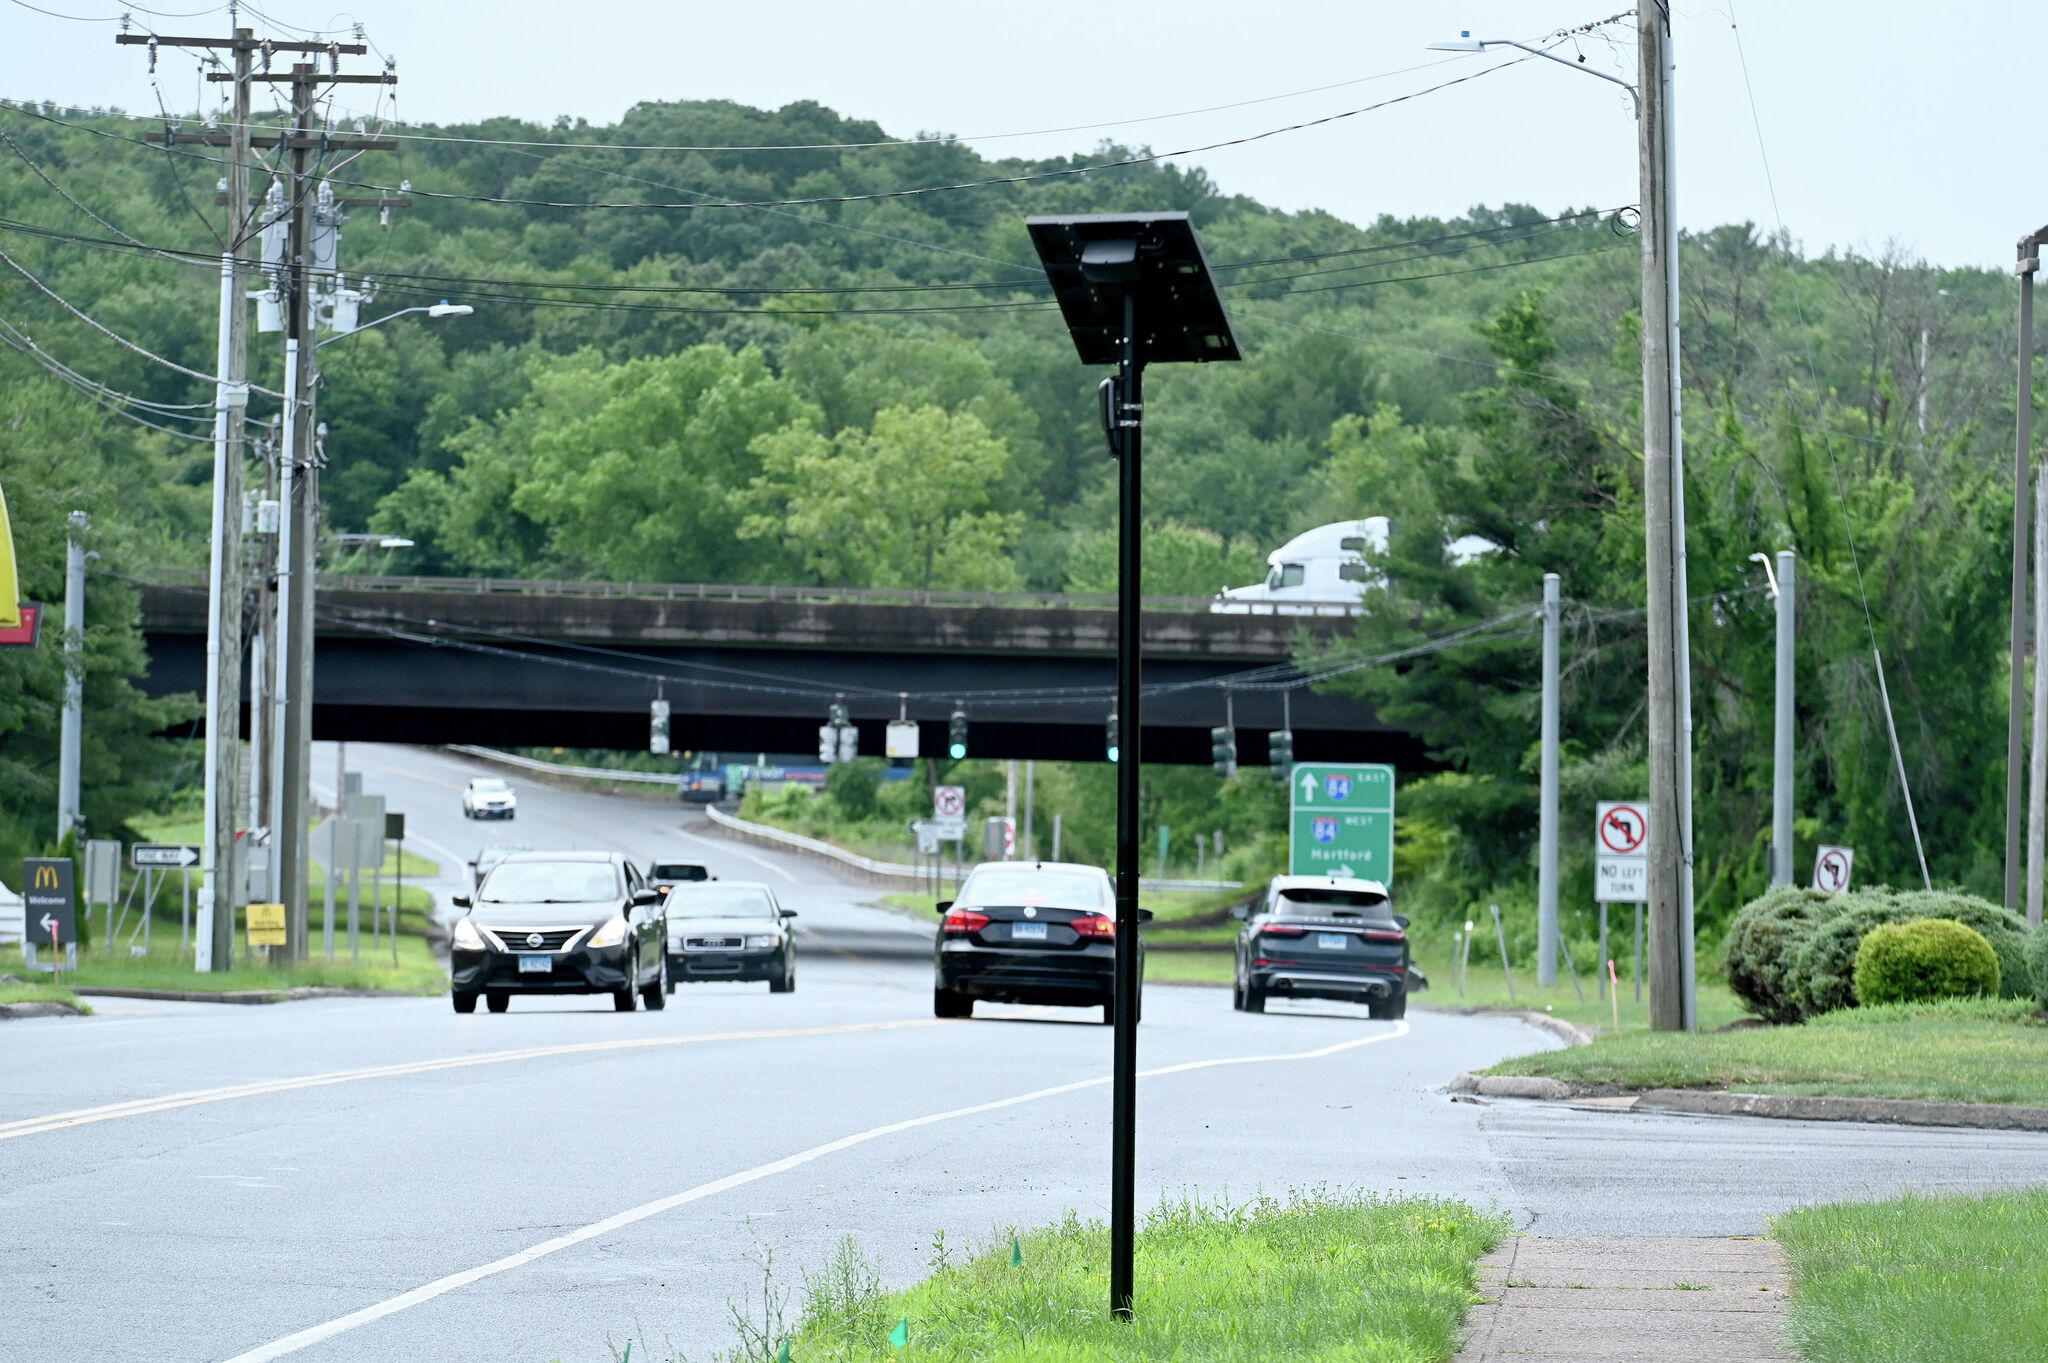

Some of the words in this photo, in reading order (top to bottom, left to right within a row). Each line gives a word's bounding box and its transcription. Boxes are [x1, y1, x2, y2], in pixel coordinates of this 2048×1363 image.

[1357, 773, 1386, 783] EAST
[1345, 816, 1373, 826] WEST
[1311, 849, 1371, 861] Hartford
[1601, 865, 1617, 878] NO
[1622, 867, 1643, 878] LEFT
[1611, 882, 1634, 894] TURN
[29, 896, 66, 905] Welcome
